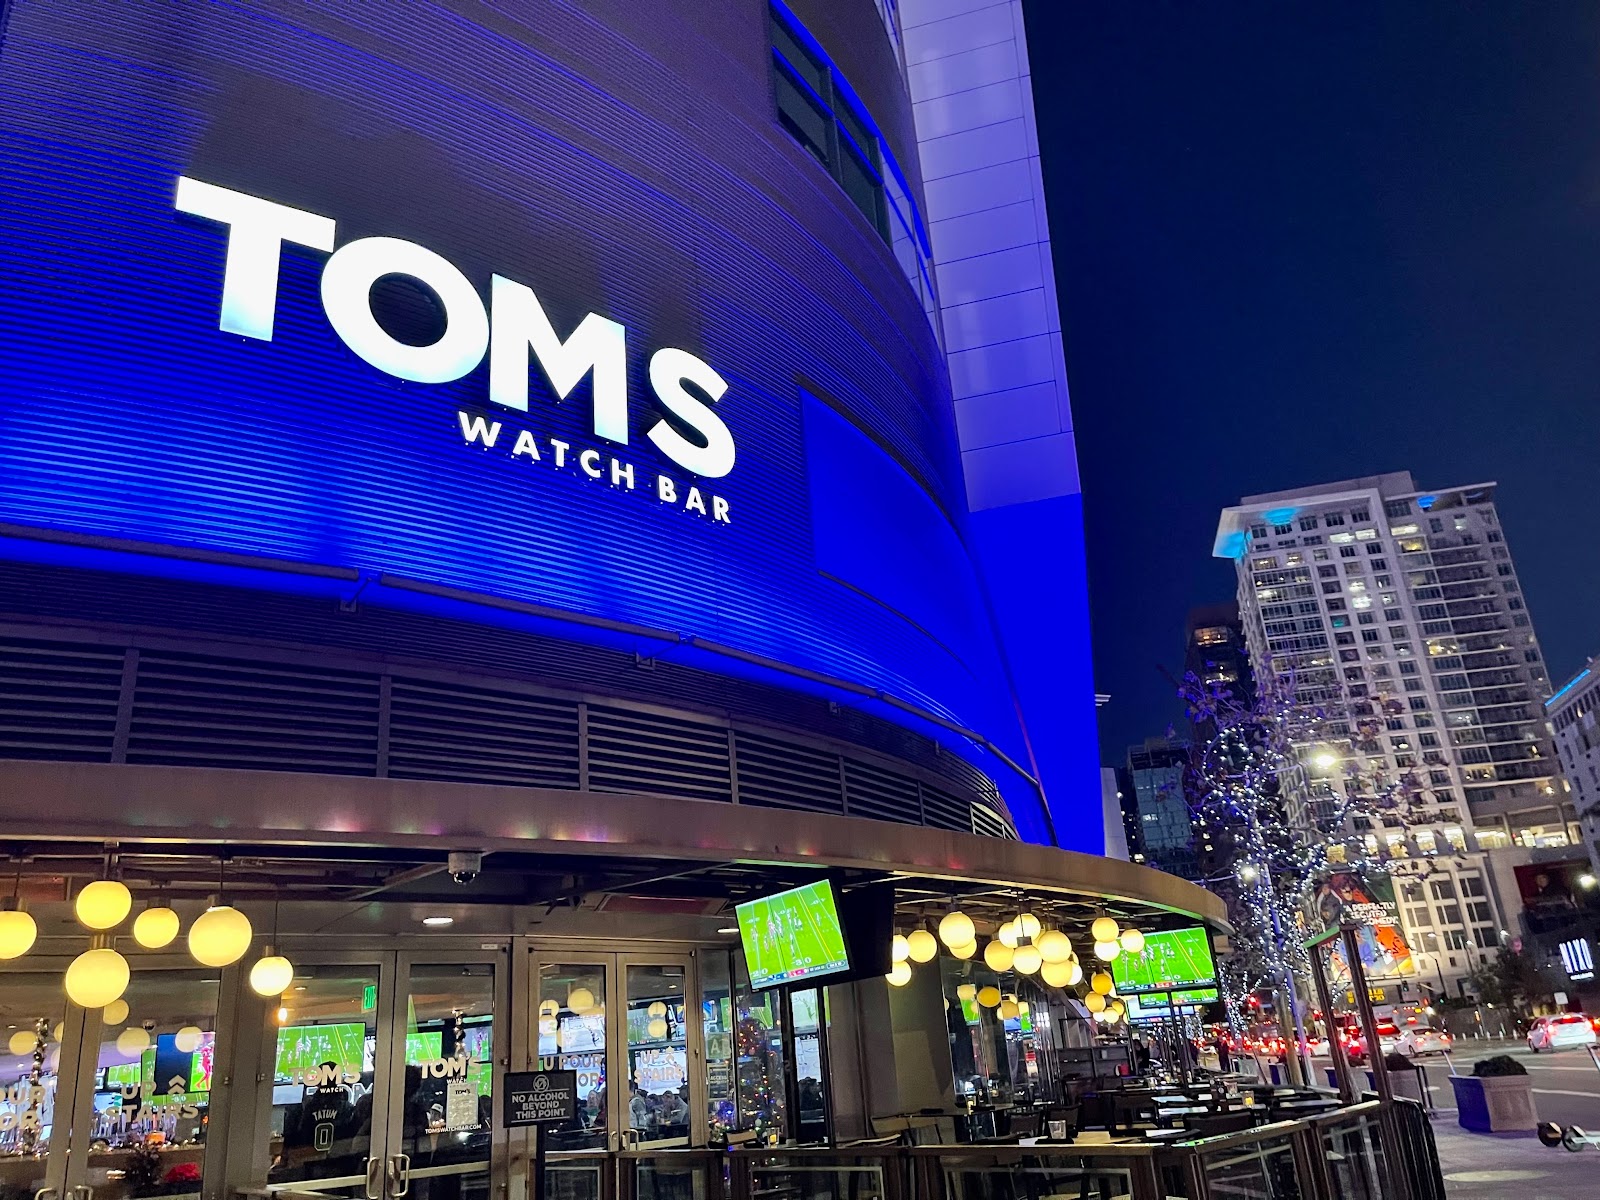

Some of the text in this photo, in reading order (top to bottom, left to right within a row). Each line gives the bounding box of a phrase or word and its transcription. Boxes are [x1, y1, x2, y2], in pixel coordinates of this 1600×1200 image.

[174, 175, 736, 479] TOMS
[458, 410, 731, 524] WATCH BAR
[640, 1050, 660, 1065] UP
[633, 1065, 684, 1084] STAIRS
[120, 1080, 157, 1100] UP
[511, 1092, 570, 1103] NO ALCOHOL
[105, 1101, 199, 1124] STAIRS
[312, 1109, 338, 1121] TATUM
[516, 1108, 566, 1120] THIS POINT
[522, 1100, 560, 1111] BEYOND
[314, 1122, 335, 1151] 0
